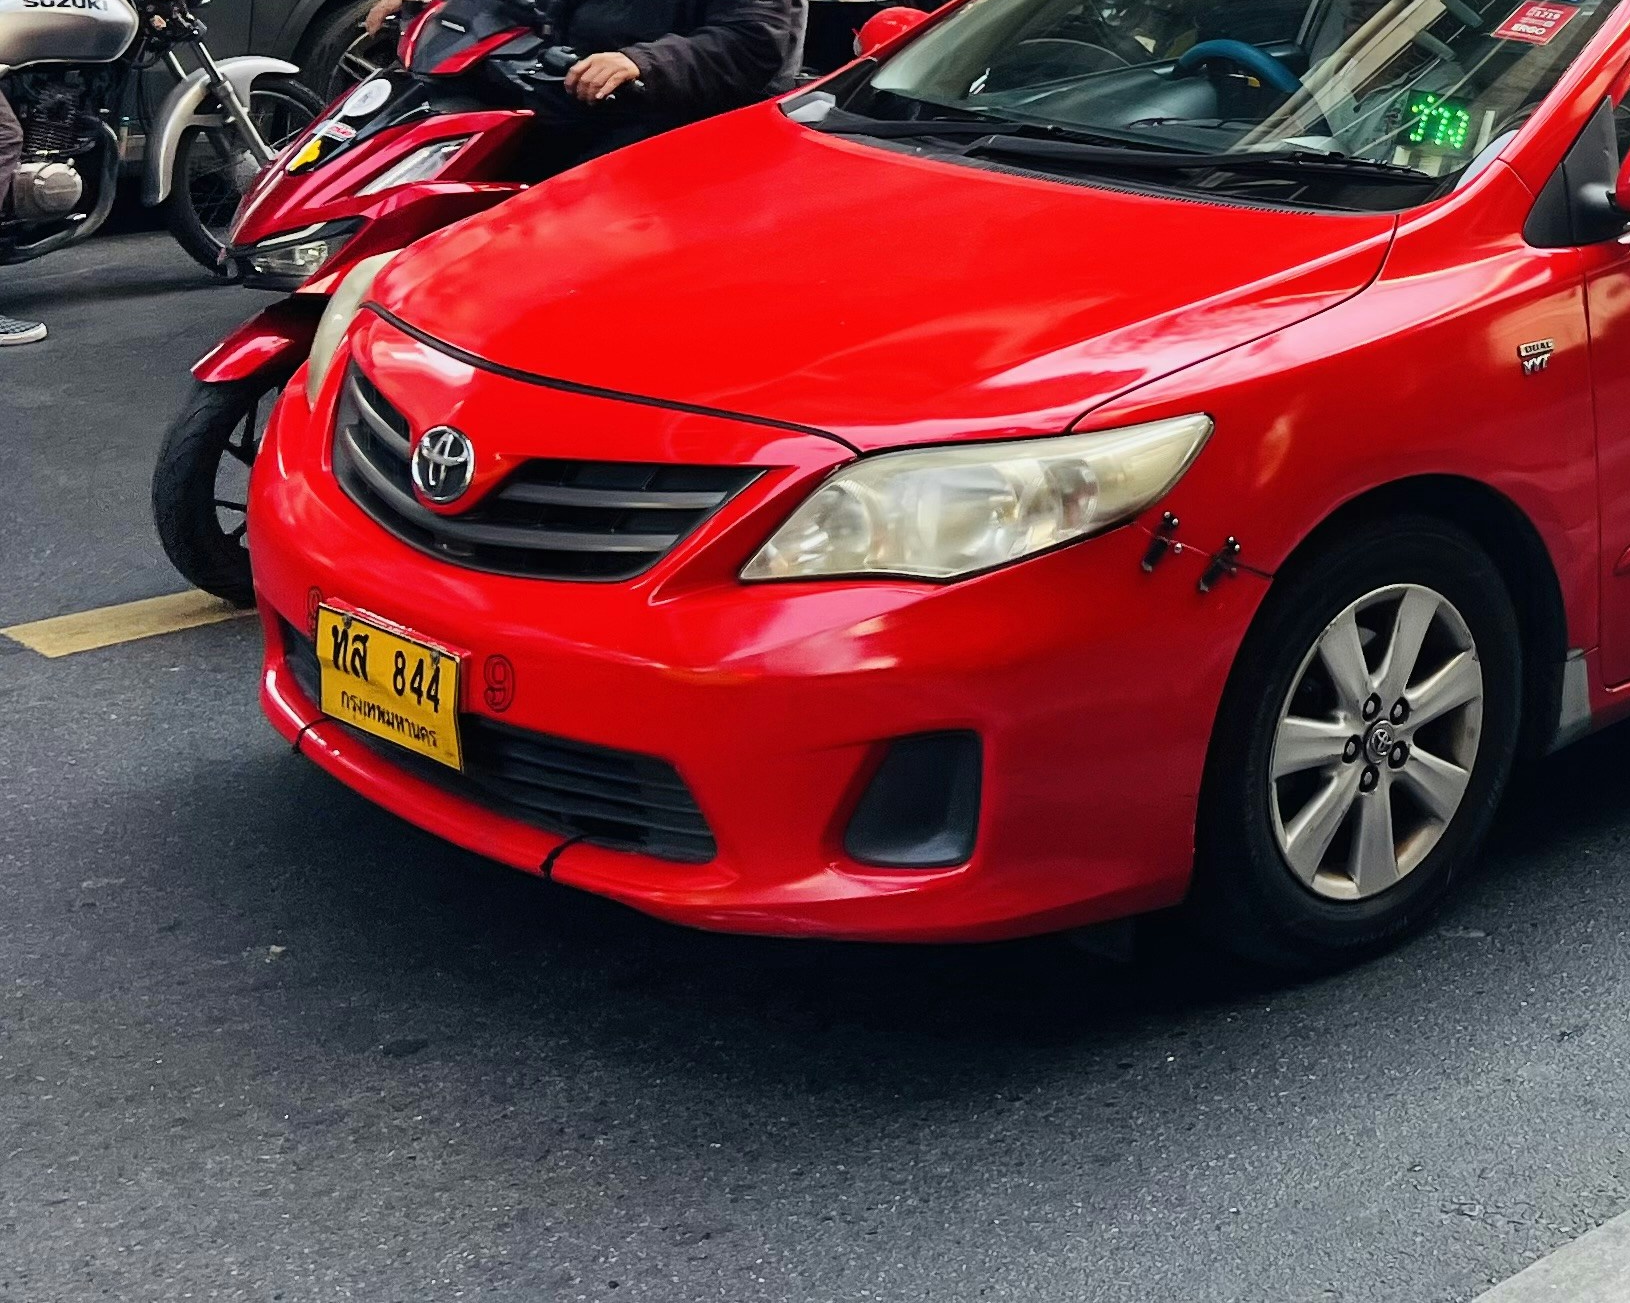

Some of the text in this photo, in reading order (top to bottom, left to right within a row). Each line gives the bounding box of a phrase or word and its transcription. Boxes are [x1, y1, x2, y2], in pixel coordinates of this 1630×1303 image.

[331, 624, 440, 714] ทส 844
[340, 689, 437, 748] กรุงเทพมหานคร
